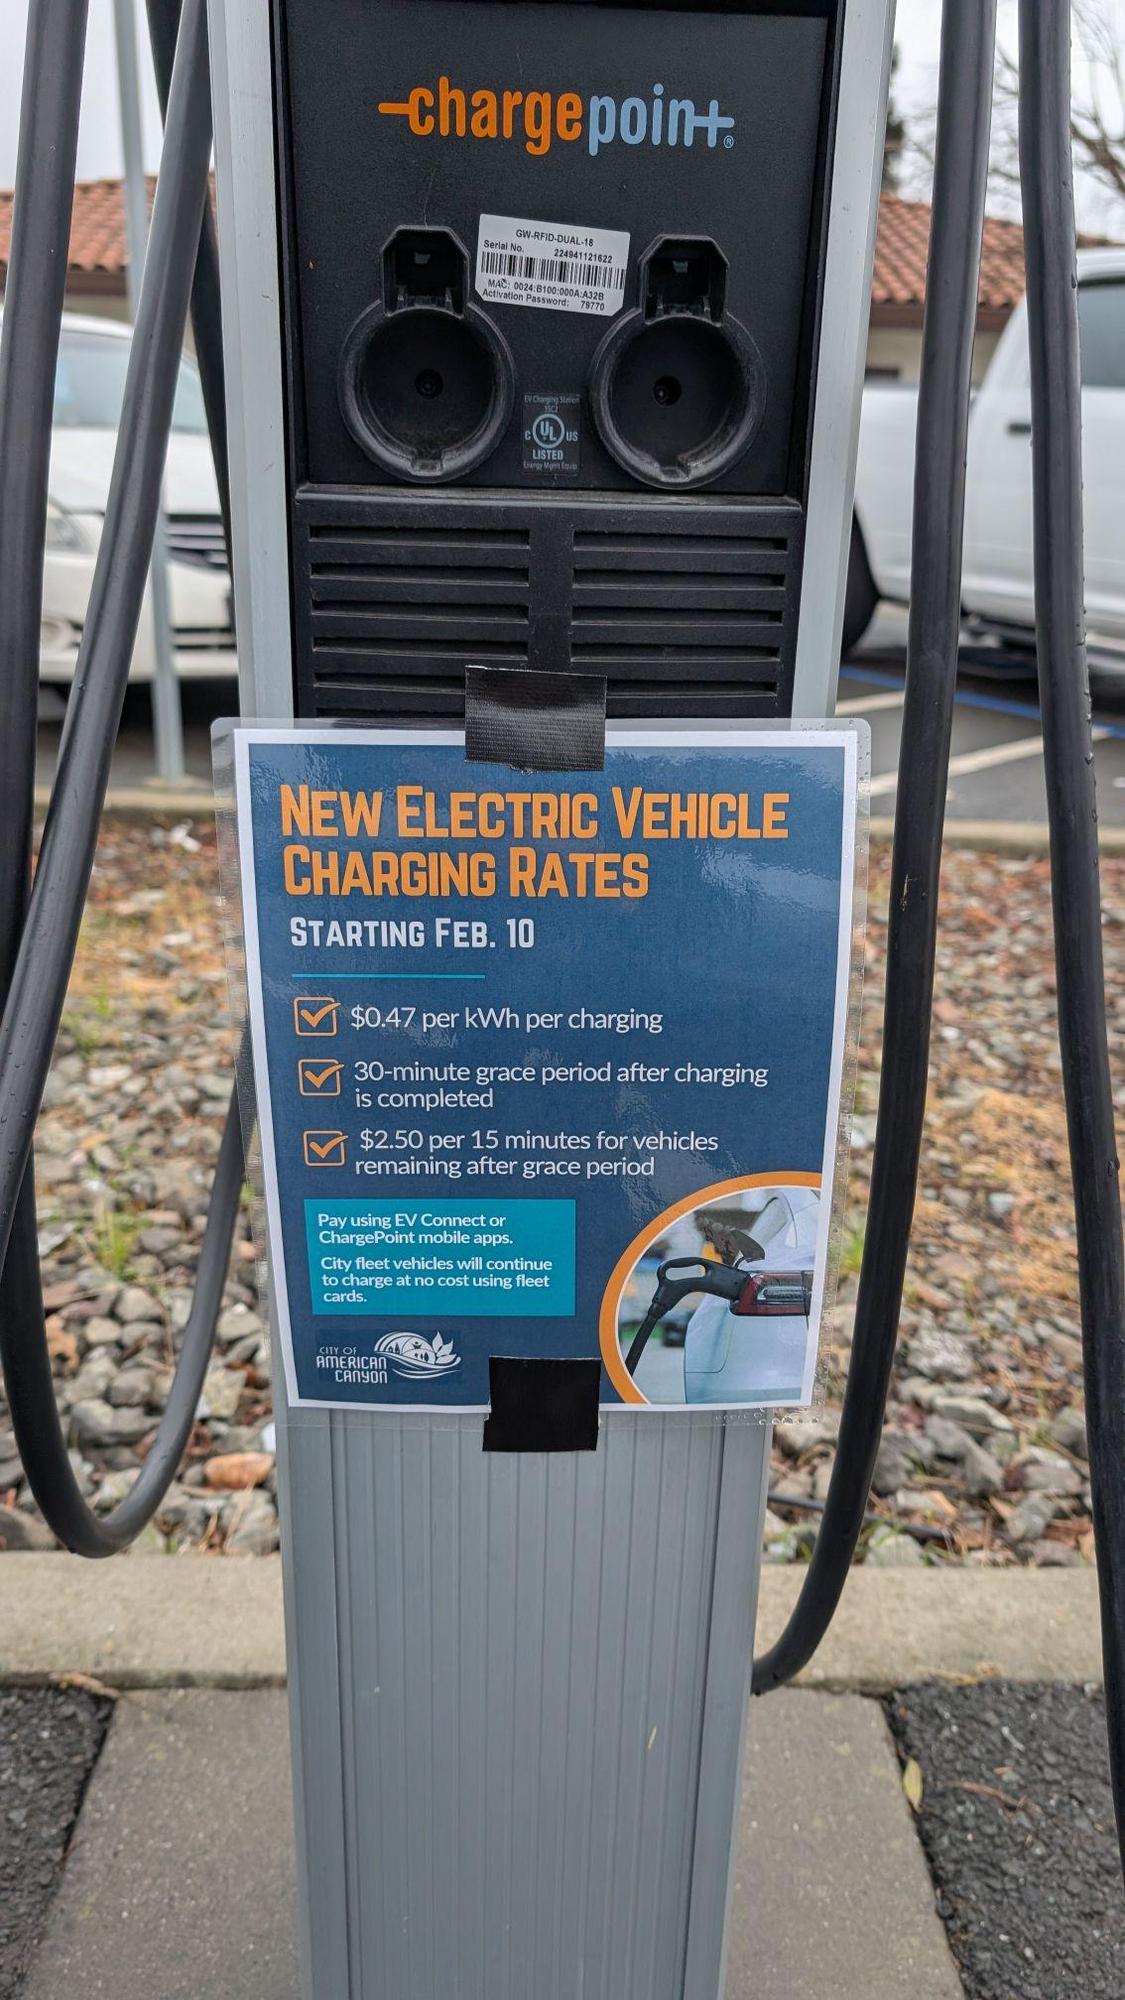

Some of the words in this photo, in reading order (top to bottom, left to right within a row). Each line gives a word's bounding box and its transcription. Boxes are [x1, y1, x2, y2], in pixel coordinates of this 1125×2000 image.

[515, 228, 594, 247] GW-RFID-DUAL-18
[483, 239, 508, 251] Serial
[510, 242, 525, 253] No.
[554, 248, 613, 264] 224941121622
[487, 278, 511, 290] MAC:
[482, 288, 524, 301] Activation
[526, 293, 570, 307] Password:
[580, 300, 605, 311] 79770
[540, 421, 557, 441] UL
[566, 431, 579, 442] US
[532, 449, 564, 460] LISTED
[281, 785, 382, 838] NEW
[398, 785, 598, 839] ELECTRIC
[612, 787, 790, 839] VEHICLE
[284, 845, 496, 897] CHARGING
[509, 847, 649, 898] RATES
[290, 916, 425, 948] STARTING
[435, 917, 496, 949] FEB.
[507, 918, 535, 949] 10
[350, 1005, 416, 1031] $0.47
[422, 1013, 460, 1033] per
[466, 1007, 520, 1030] kWh
[526, 1013, 564, 1033] per
[568, 1007, 663, 1034] charging
[354, 1061, 471, 1082] 30-minute
[476, 1066, 536, 1086] grace
[542, 1062, 611, 1086] period
[616, 1062, 670, 1083] after
[674, 1062, 769, 1088] charging
[355, 1087, 372, 1108] is
[377, 1087, 493, 1112] completed
[360, 1127, 424, 1152] $2.50
[429, 1135, 466, 1154] per
[471, 1130, 499, 1149] 15
[505, 1130, 591, 1151] minutes
[596, 1130, 629, 1150] for
[632, 1130, 719, 1152] vehicles
[355, 1156, 462, 1179] remaining
[466, 1155, 518, 1176] after
[522, 1161, 581, 1180] grace
[586, 1156, 655, 1179] period
[318, 1213, 347, 1230] Pay
[350, 1213, 392, 1230] using
[395, 1213, 417, 1227] EV
[420, 1213, 486, 1227] Connect
[489, 1216, 506, 1227] or
[319, 1230, 415, 1247] ChargePoint
[418, 1230, 470, 1245] mobile
[473, 1234, 514, 1247] apps.
[320, 1256, 352, 1272] City
[355, 1256, 390, 1270] fleet
[393, 1256, 454, 1271] vehicles
[457, 1256, 483, 1271] will
[486, 1257, 552, 1272] continue
[322, 1275, 339, 1287] to
[342, 1273, 393, 1290] charge
[396, 1275, 411, 1287] at
[414, 1277, 434, 1287] no
[437, 1275, 469, 1288] cost
[472, 1274, 513, 1290] using
[515, 1273, 550, 1288] fleet
[323, 1289, 367, 1303] cards.
[319, 1346, 339, 1355] CITY
[343, 1346, 357, 1355] OF
[316, 1355, 387, 1370] AMERICAN
[335, 1369, 388, 1384] CANYON
